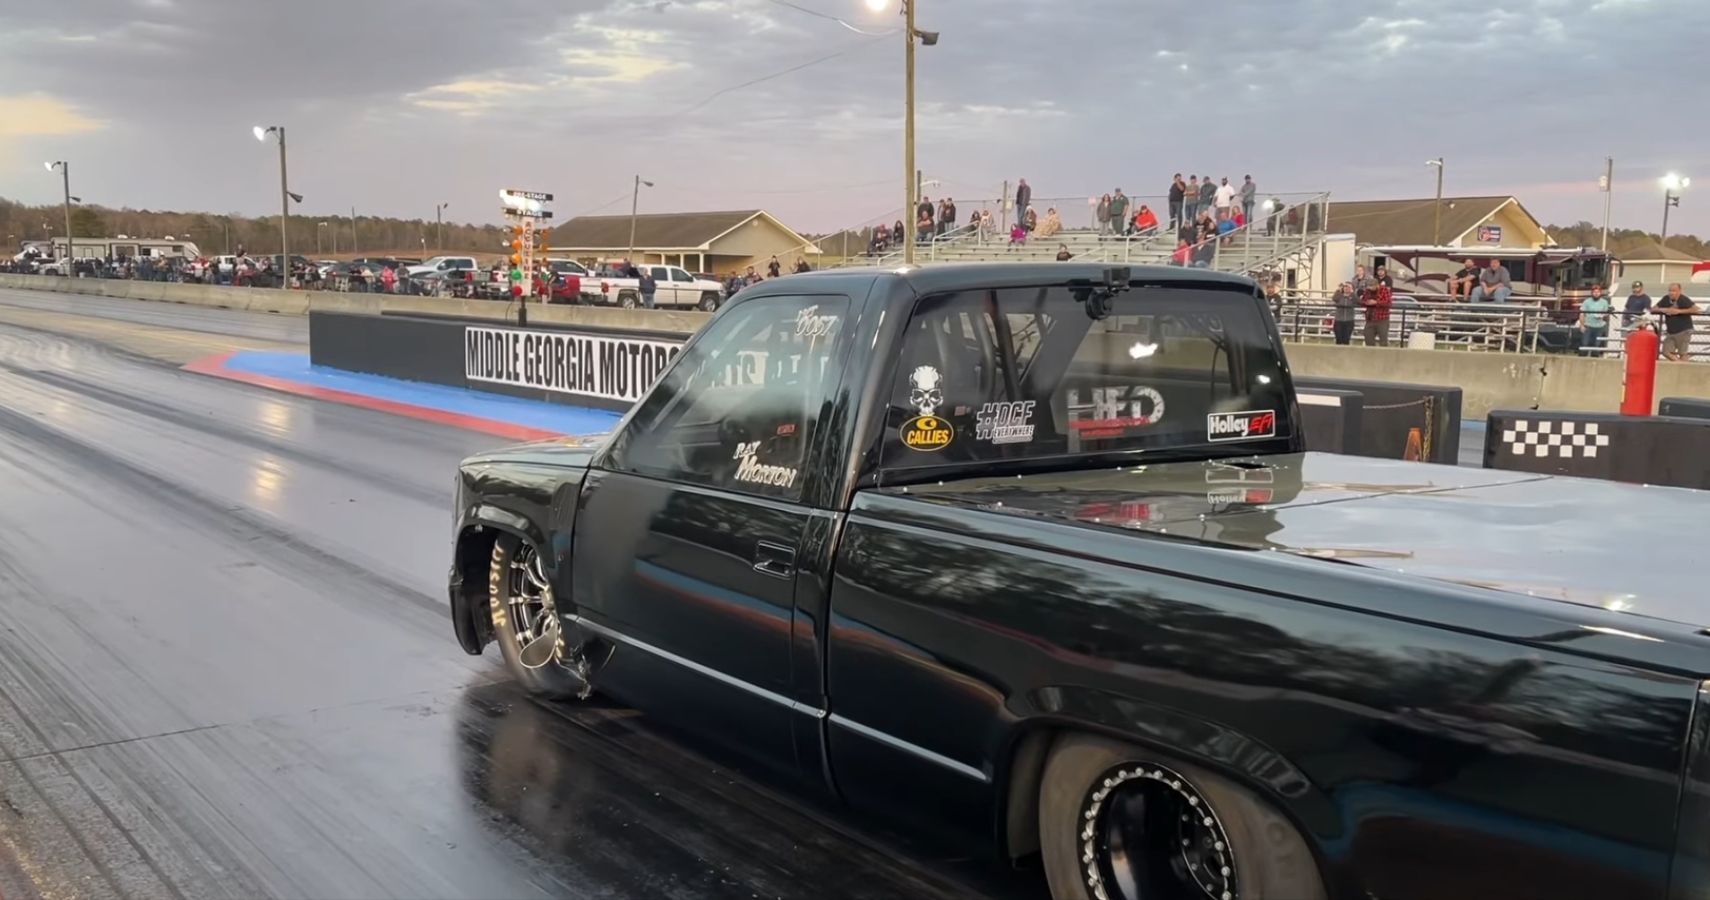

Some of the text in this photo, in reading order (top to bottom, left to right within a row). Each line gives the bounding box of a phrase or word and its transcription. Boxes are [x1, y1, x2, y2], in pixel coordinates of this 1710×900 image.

[467, 329, 680, 398] MIDDLE GEORGIA MOTOR
[1210, 415, 1249, 437] Holley
[907, 430, 949, 445] CALLIES
